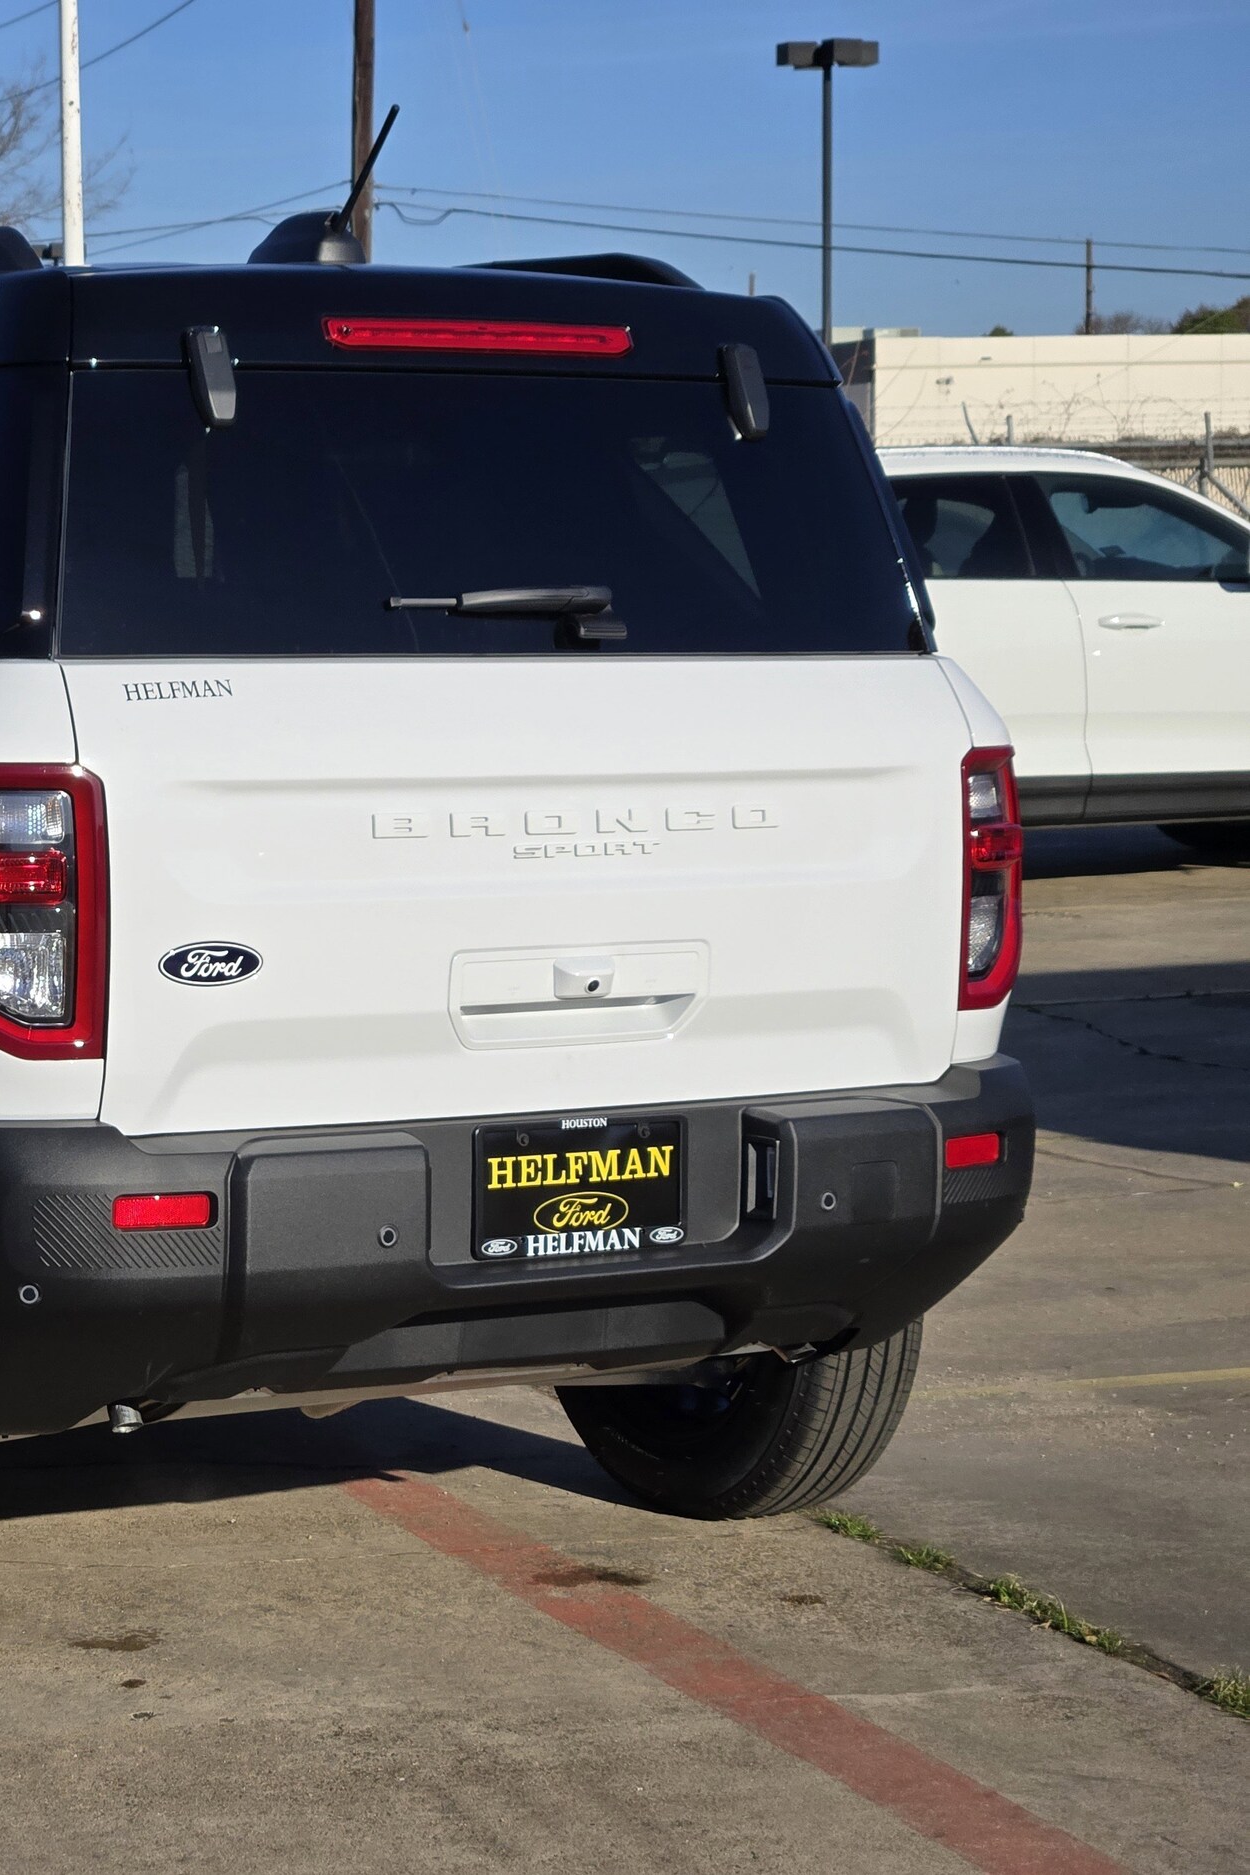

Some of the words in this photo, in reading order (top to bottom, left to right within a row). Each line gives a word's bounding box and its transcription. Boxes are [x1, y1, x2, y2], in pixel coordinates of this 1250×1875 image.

[121, 679, 233, 701] HELFMAN
[371, 804, 780, 839] BRONCO
[513, 841, 661, 860] SPORT
[180, 949, 244, 977] Ford
[561, 1117, 608, 1129] HOUSTON
[487, 1145, 674, 1189] HELFMAN
[552, 1197, 612, 1227] Ford
[526, 1228, 642, 1256] HELFMAN
